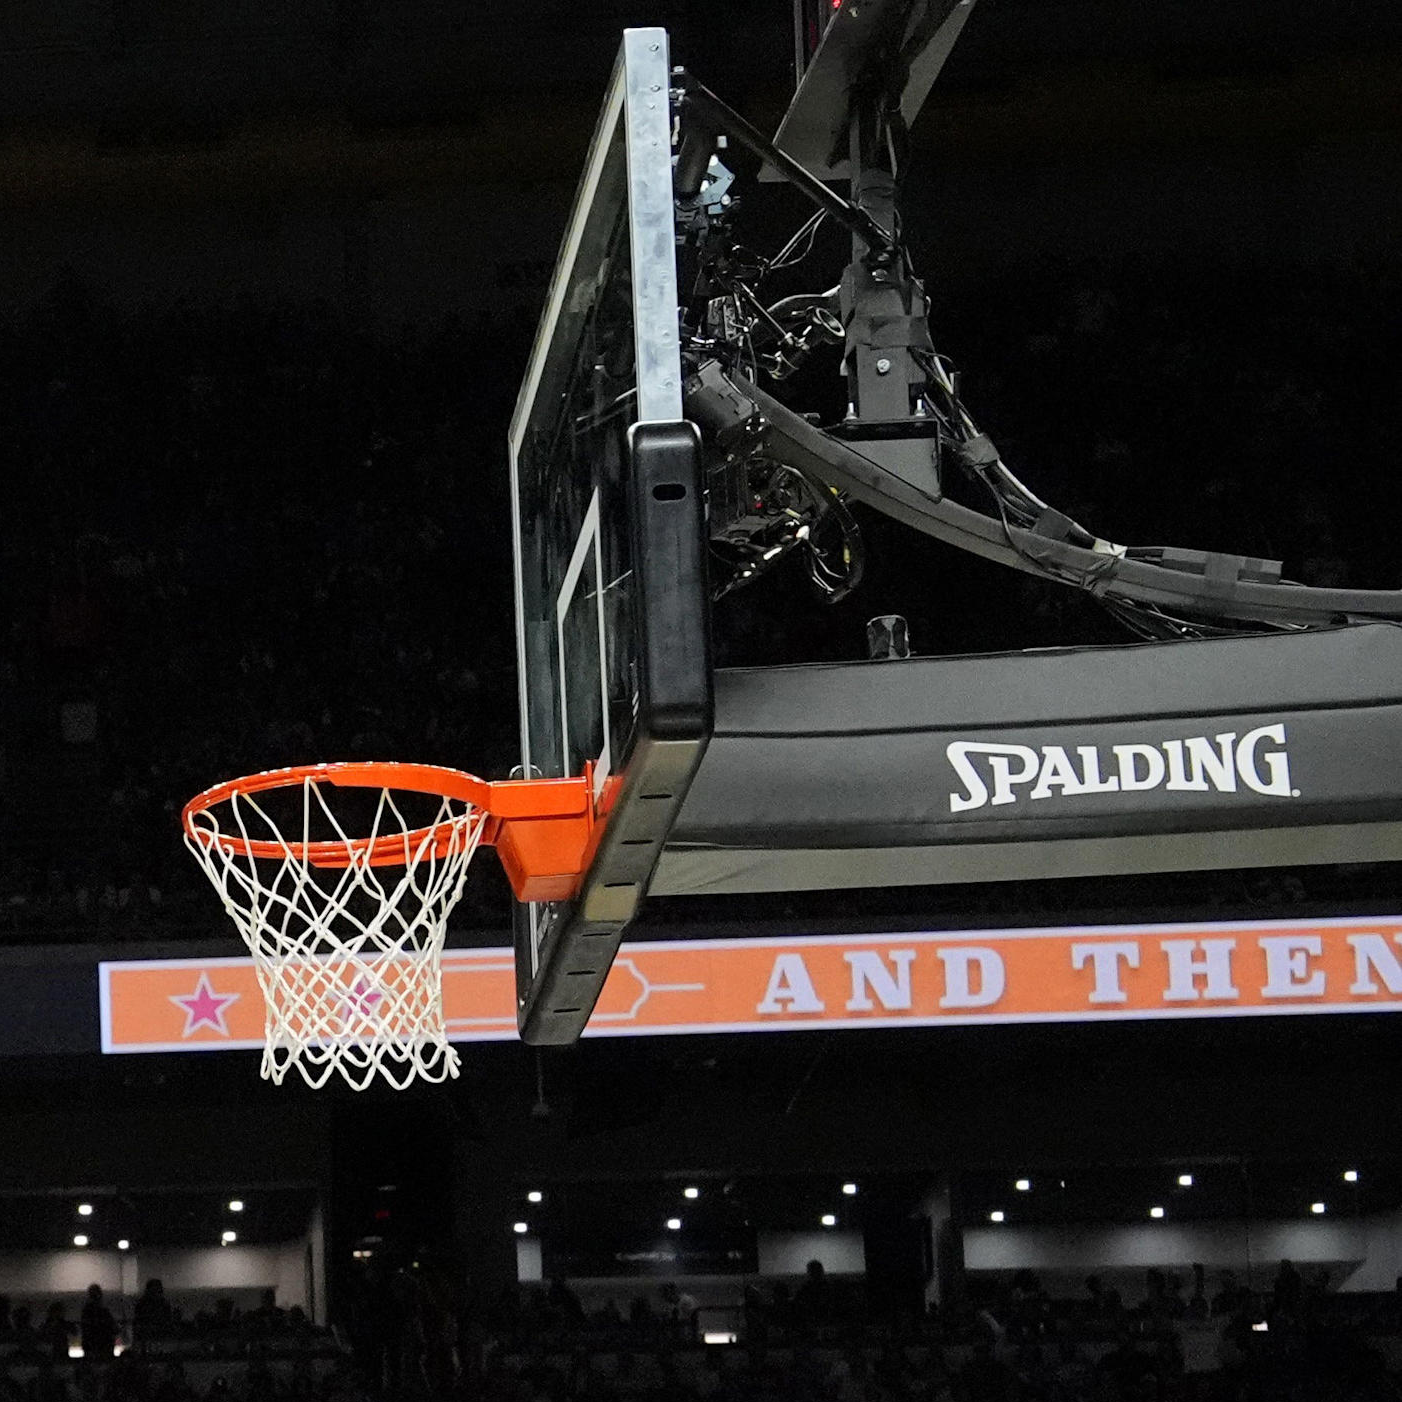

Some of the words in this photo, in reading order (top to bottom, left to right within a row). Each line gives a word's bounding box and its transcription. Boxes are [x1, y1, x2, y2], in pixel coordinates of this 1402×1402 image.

[946, 723, 1293, 813] SPALDING
[756, 946, 1007, 1015] AND
[1072, 932, 1402, 1003] THEN
